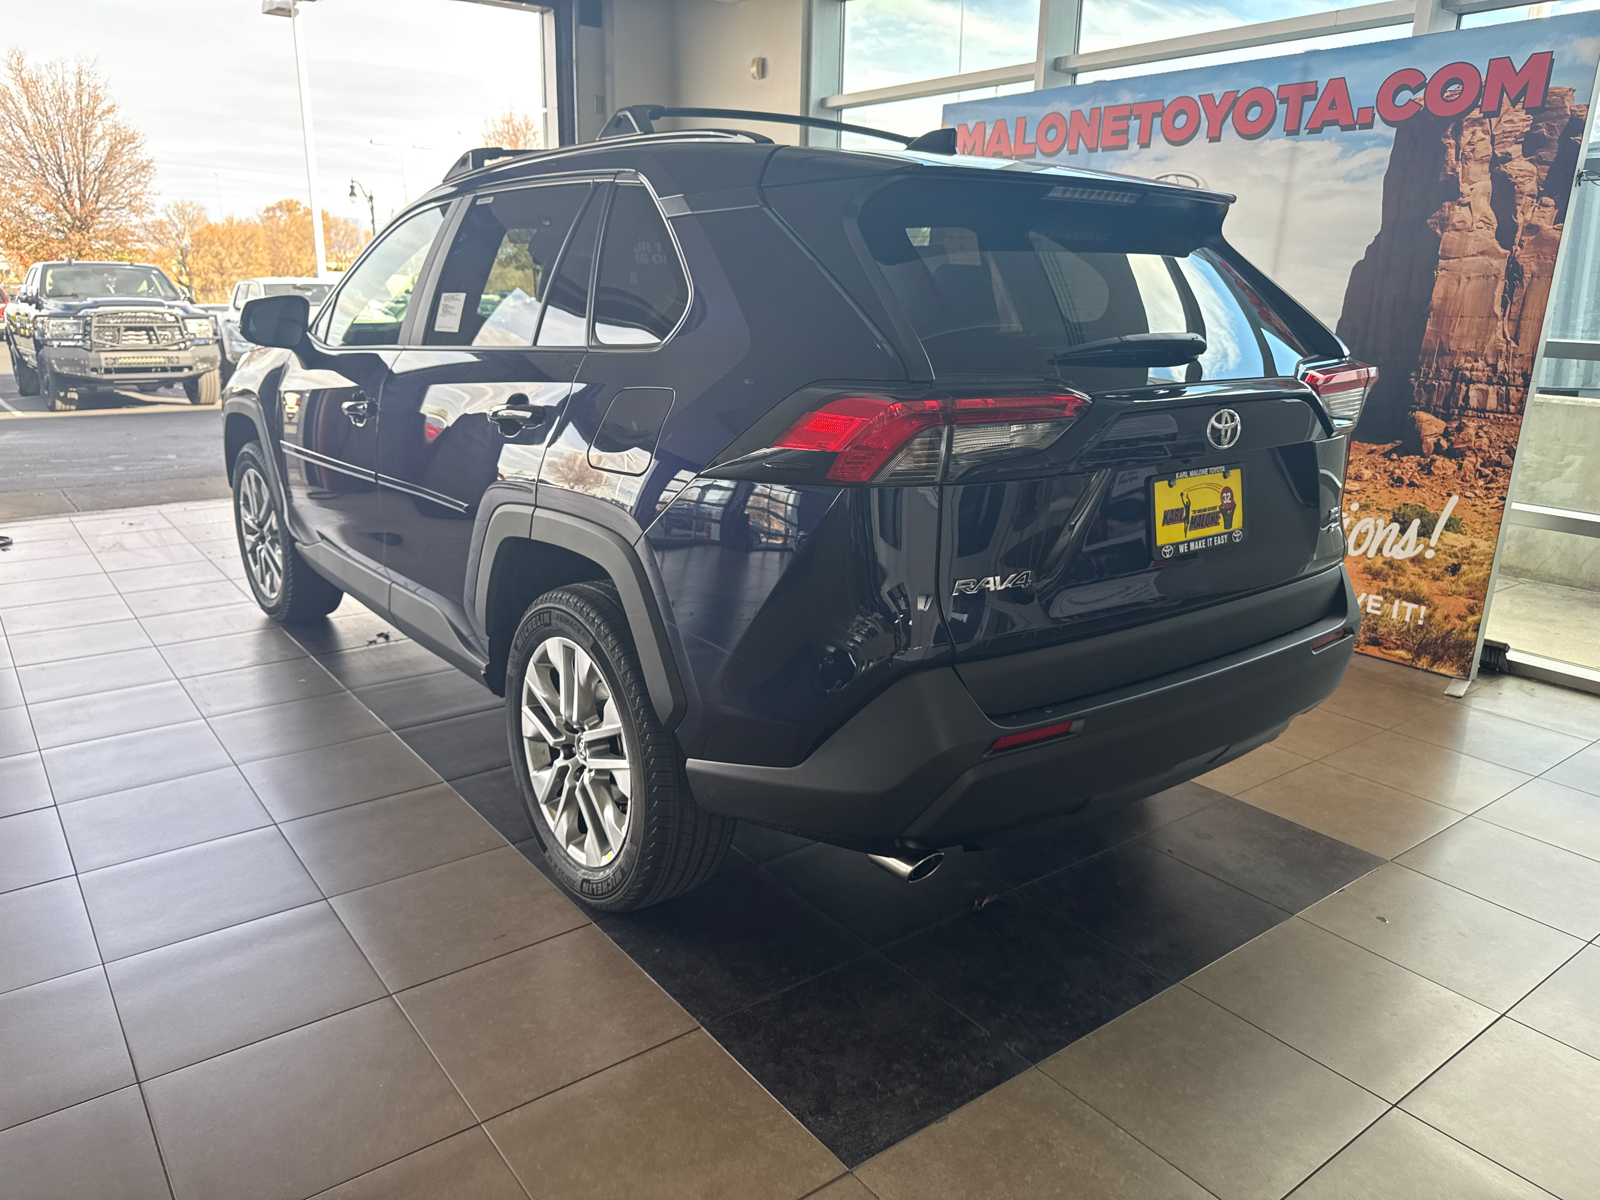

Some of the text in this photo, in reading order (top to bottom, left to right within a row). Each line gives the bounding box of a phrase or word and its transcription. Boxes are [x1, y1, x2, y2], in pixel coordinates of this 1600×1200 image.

[1176, 466, 1225, 479] KARL MALONE TOYOTA
[1222, 492, 1231, 503] 32
[1162, 507, 1184, 527] KARL
[1189, 511, 1221, 531] MALONE
[1179, 534, 1228, 553] WE MAKE IT EASY
[952, 570, 1031, 596] RAV4
[1391, 599, 1426, 626] IT!
[516, 612, 550, 649] MICHELIN
[582, 867, 623, 895] MICHELIN
